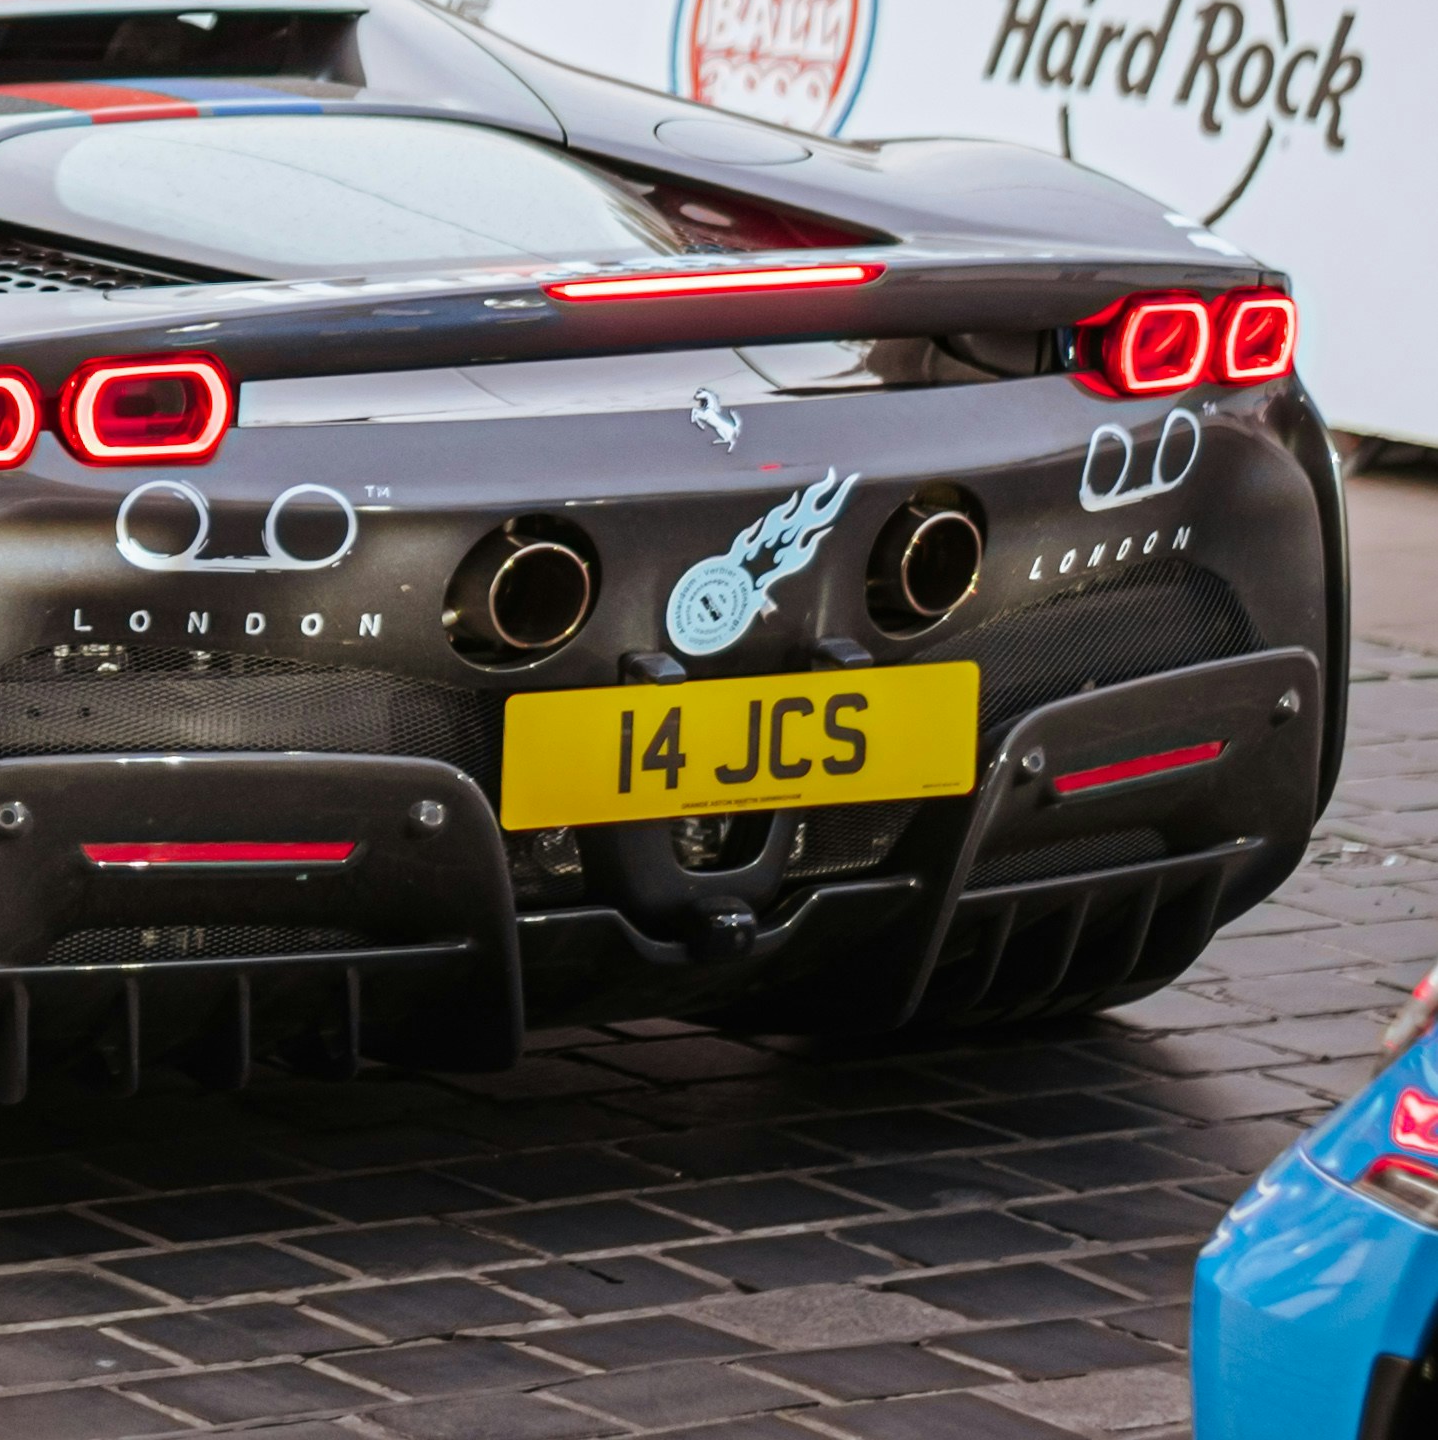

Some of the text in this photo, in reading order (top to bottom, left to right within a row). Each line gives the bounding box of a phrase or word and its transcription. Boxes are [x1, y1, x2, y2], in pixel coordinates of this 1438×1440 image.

[1175, 1, 1364, 151] Rock
[1029, 526, 1191, 580] LONDON
[74, 608, 382, 637] LONDON
[617, 693, 869, 794] 14 JCS
